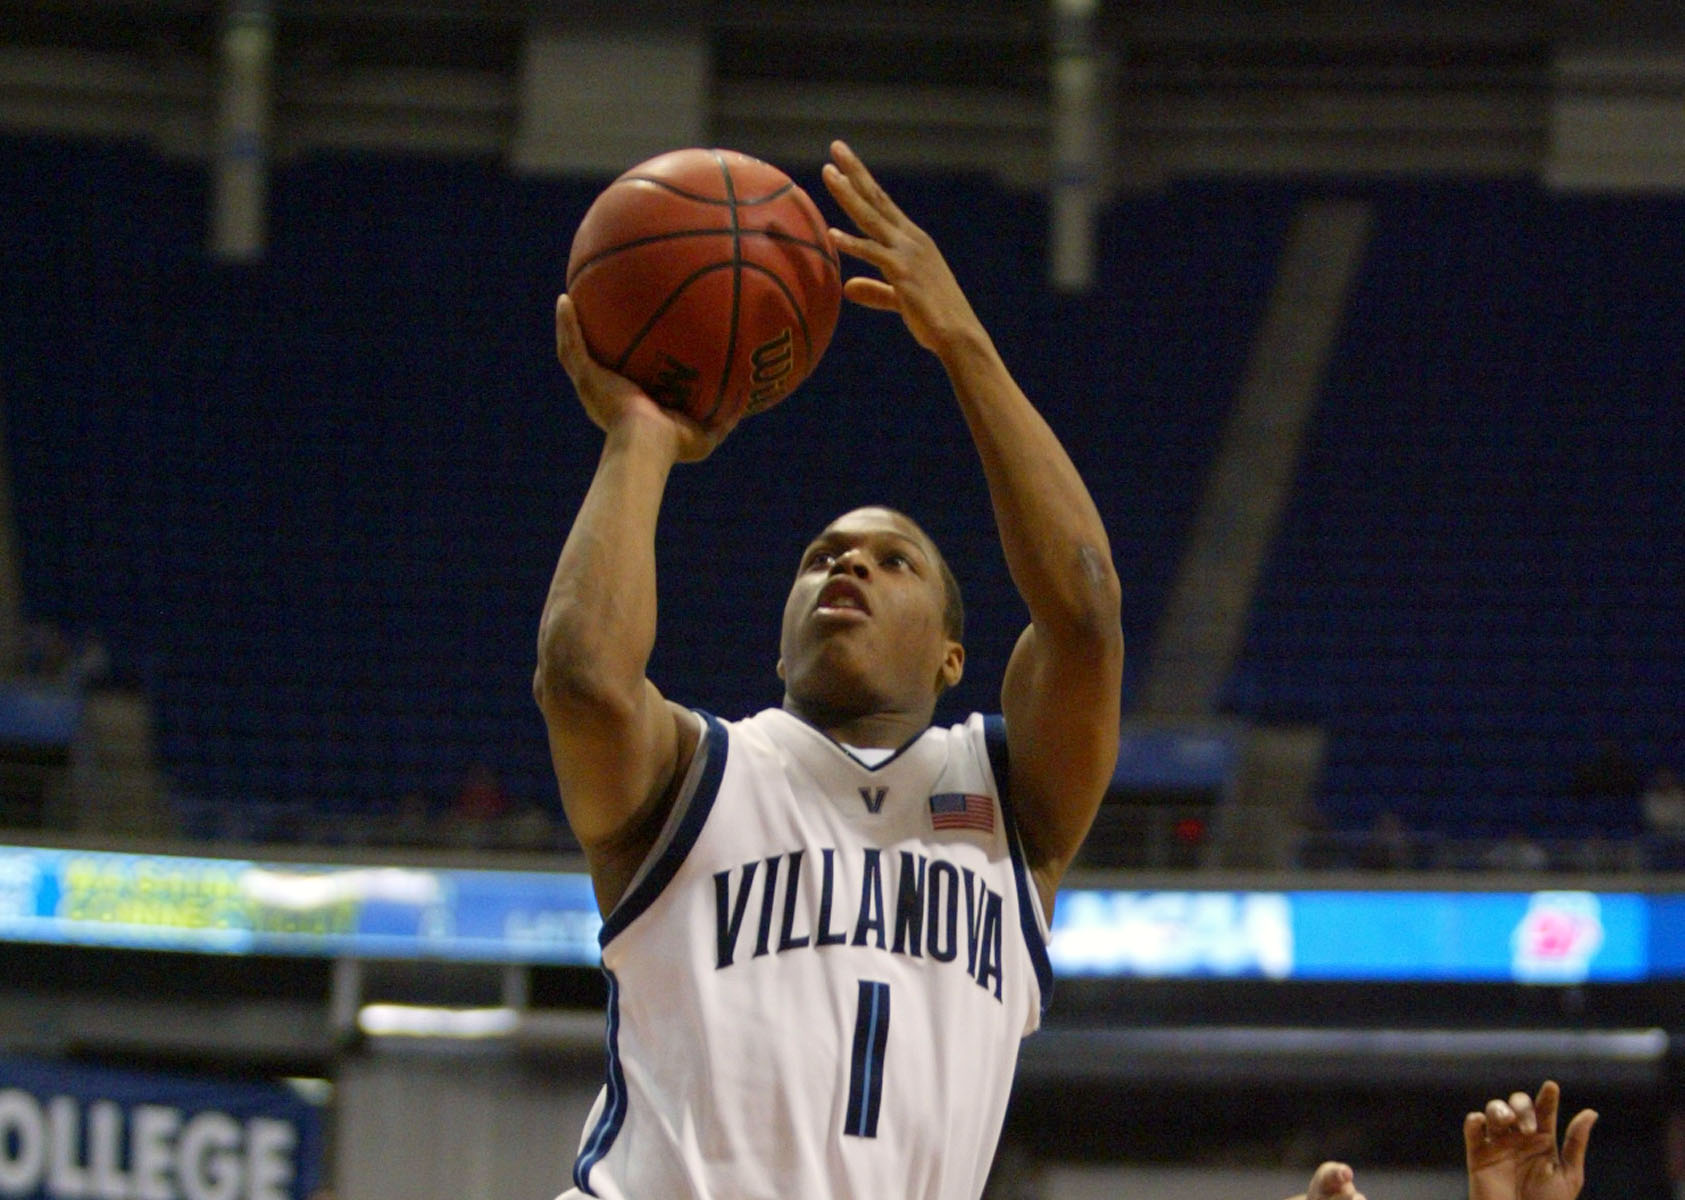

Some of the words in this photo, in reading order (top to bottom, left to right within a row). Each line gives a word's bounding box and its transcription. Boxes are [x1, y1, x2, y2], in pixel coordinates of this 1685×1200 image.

[858, 786, 890, 814] V
[713, 847, 1004, 1005] VILLANOVA
[843, 979, 891, 1139] 1
